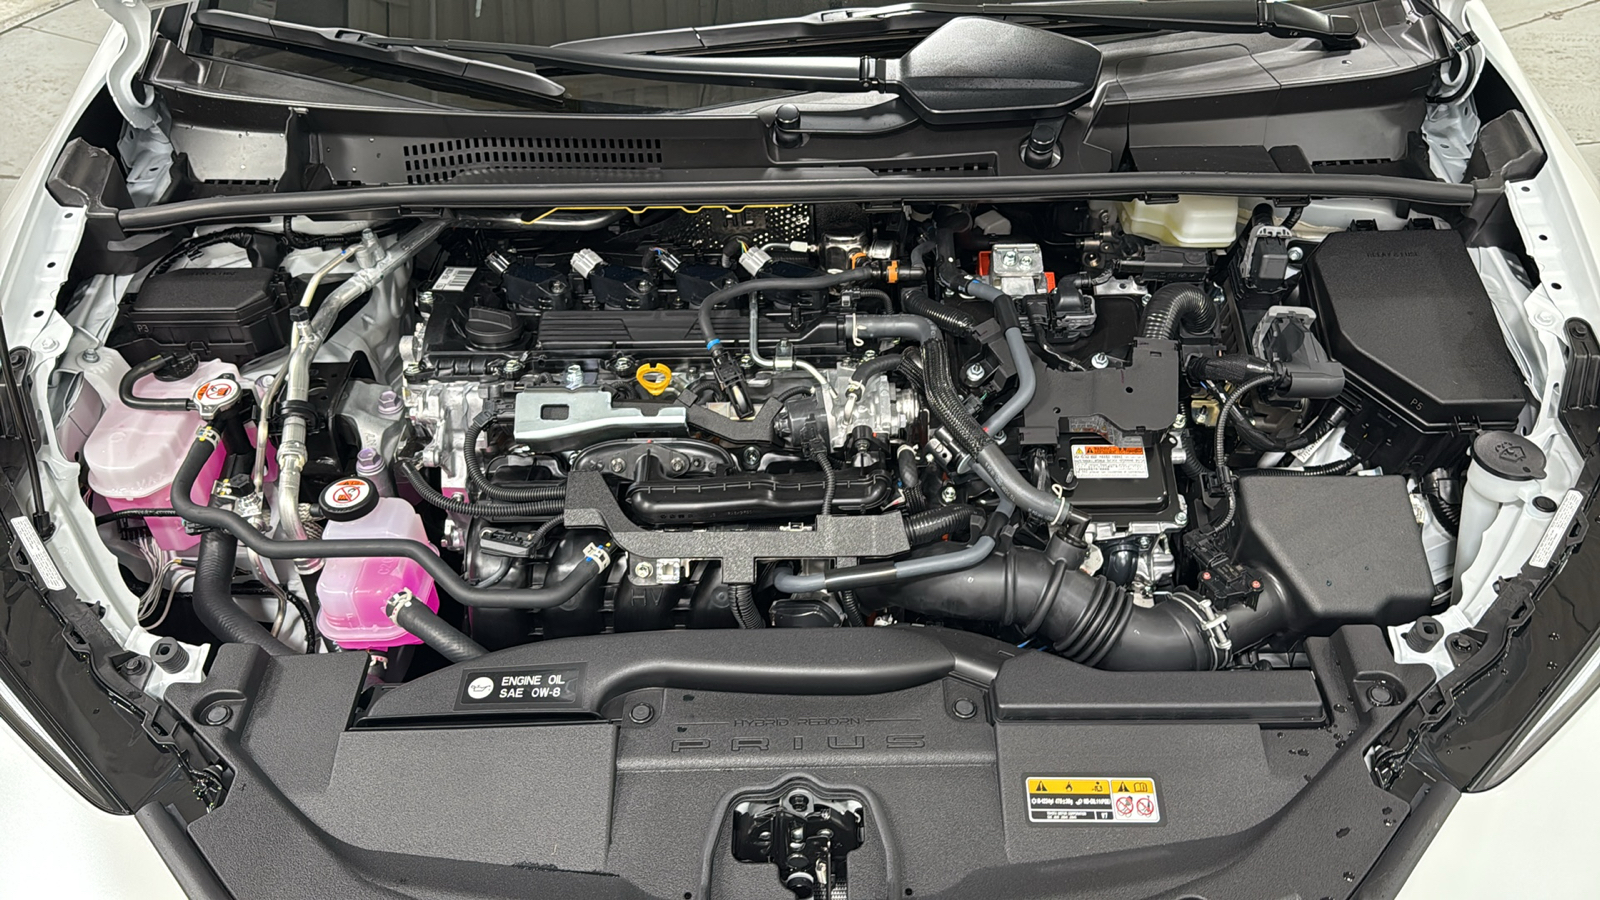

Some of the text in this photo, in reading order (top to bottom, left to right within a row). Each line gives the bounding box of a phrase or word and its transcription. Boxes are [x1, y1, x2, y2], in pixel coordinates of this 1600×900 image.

[137, 324, 149, 333] P3
[1410, 398, 1424, 411] P5
[631, 588, 663, 606] HV
[501, 674, 565, 686] ENGINE OIL
[499, 687, 561, 698] SAE 0W-8
[733, 717, 861, 727] HYBRID REBORN
[671, 734, 926, 753] PRIUS
